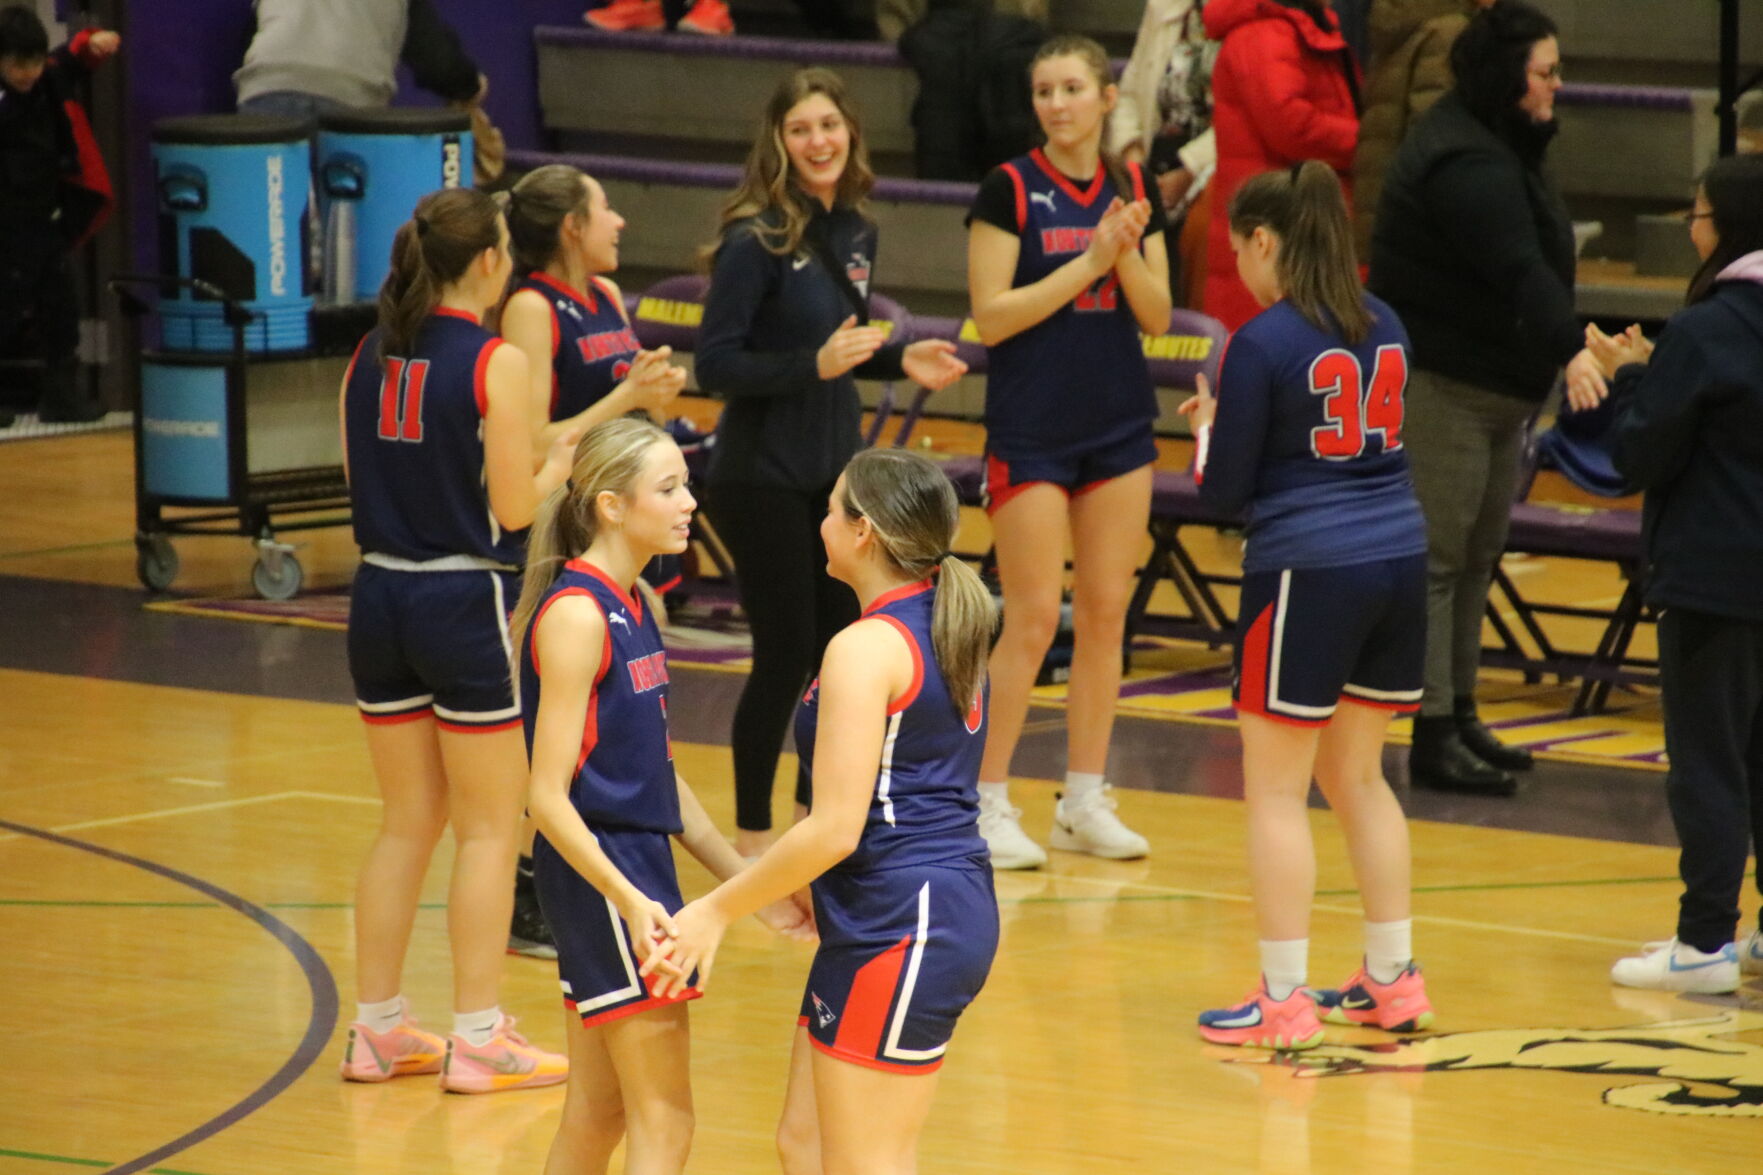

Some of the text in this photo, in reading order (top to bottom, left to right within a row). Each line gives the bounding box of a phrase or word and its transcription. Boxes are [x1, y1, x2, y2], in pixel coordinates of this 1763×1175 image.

[266, 155, 286, 296] POWERADE
[377, 355, 431, 442] 11
[1308, 343, 1408, 462] 34
